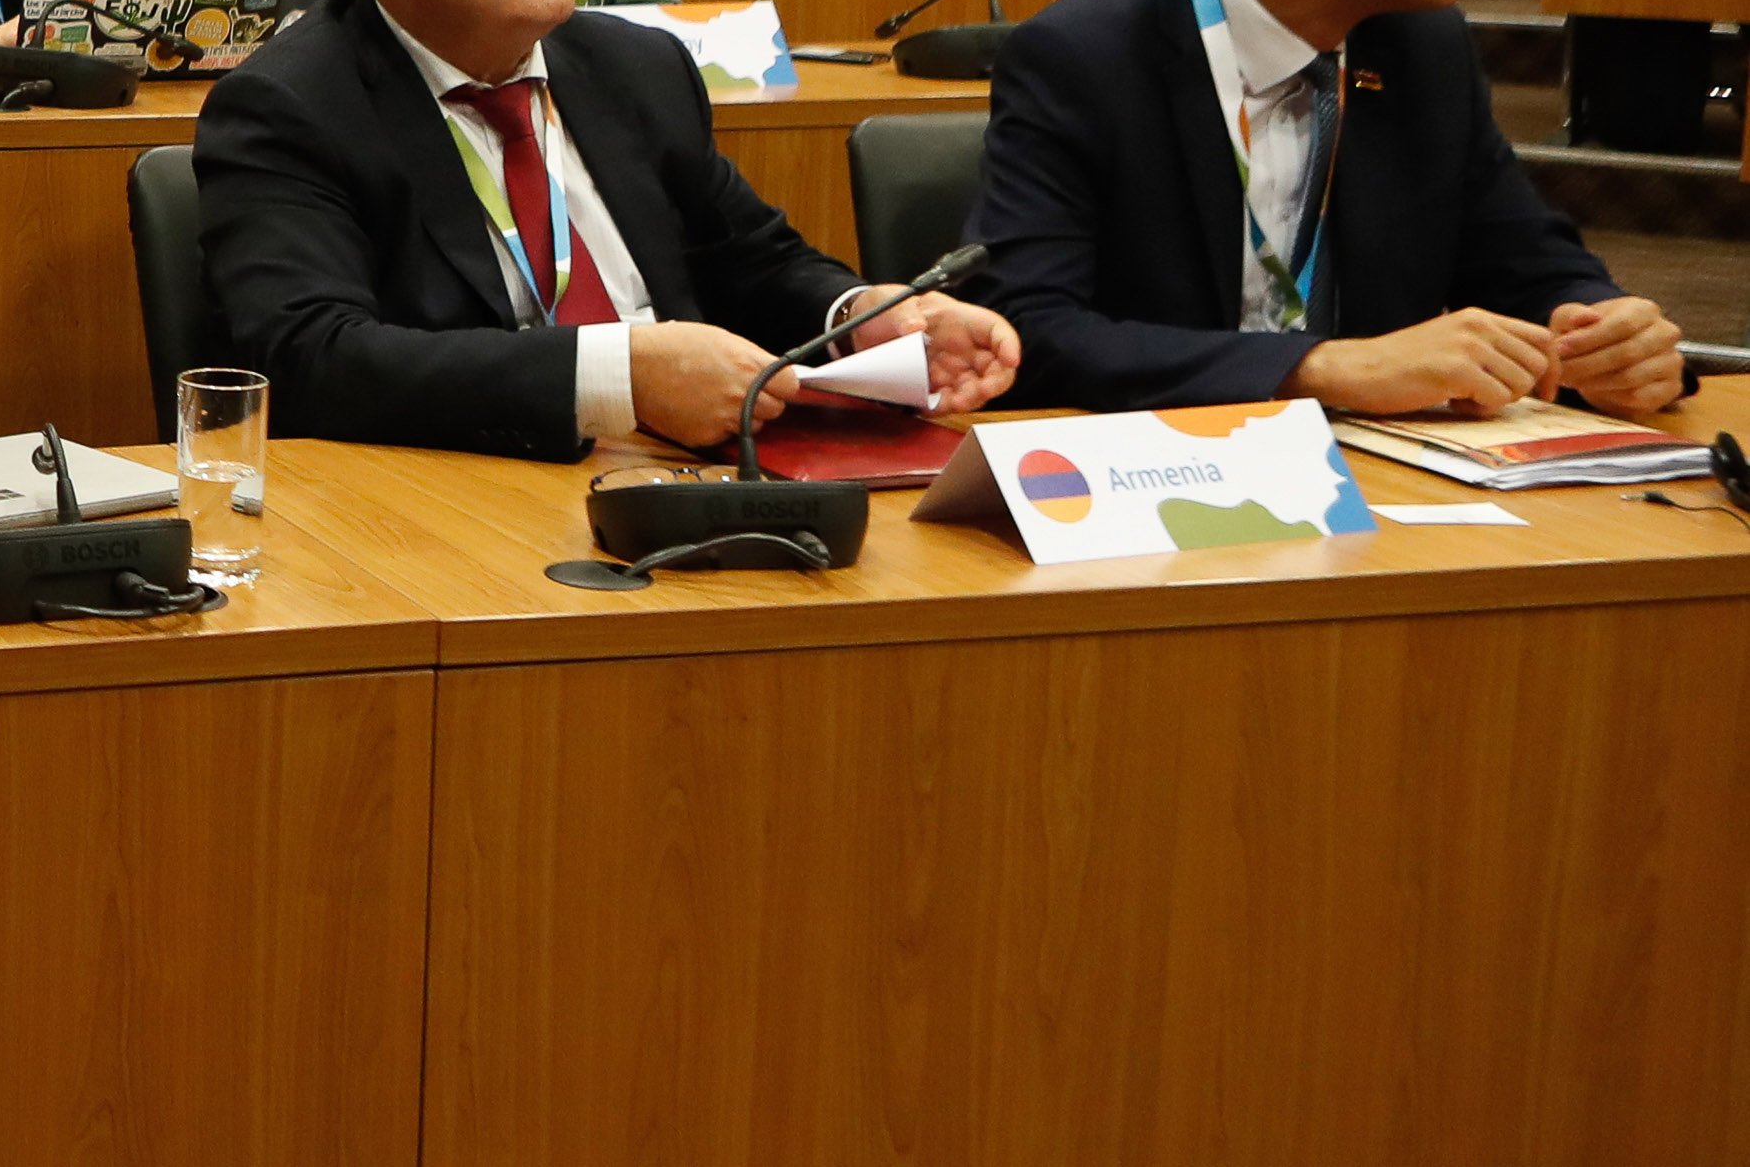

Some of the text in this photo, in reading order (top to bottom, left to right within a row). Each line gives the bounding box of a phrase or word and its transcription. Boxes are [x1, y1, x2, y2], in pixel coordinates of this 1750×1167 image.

[1108, 457, 1224, 492] Armenia
[742, 499, 821, 520] BOSCH
[60, 538, 141, 565] BOSCH
